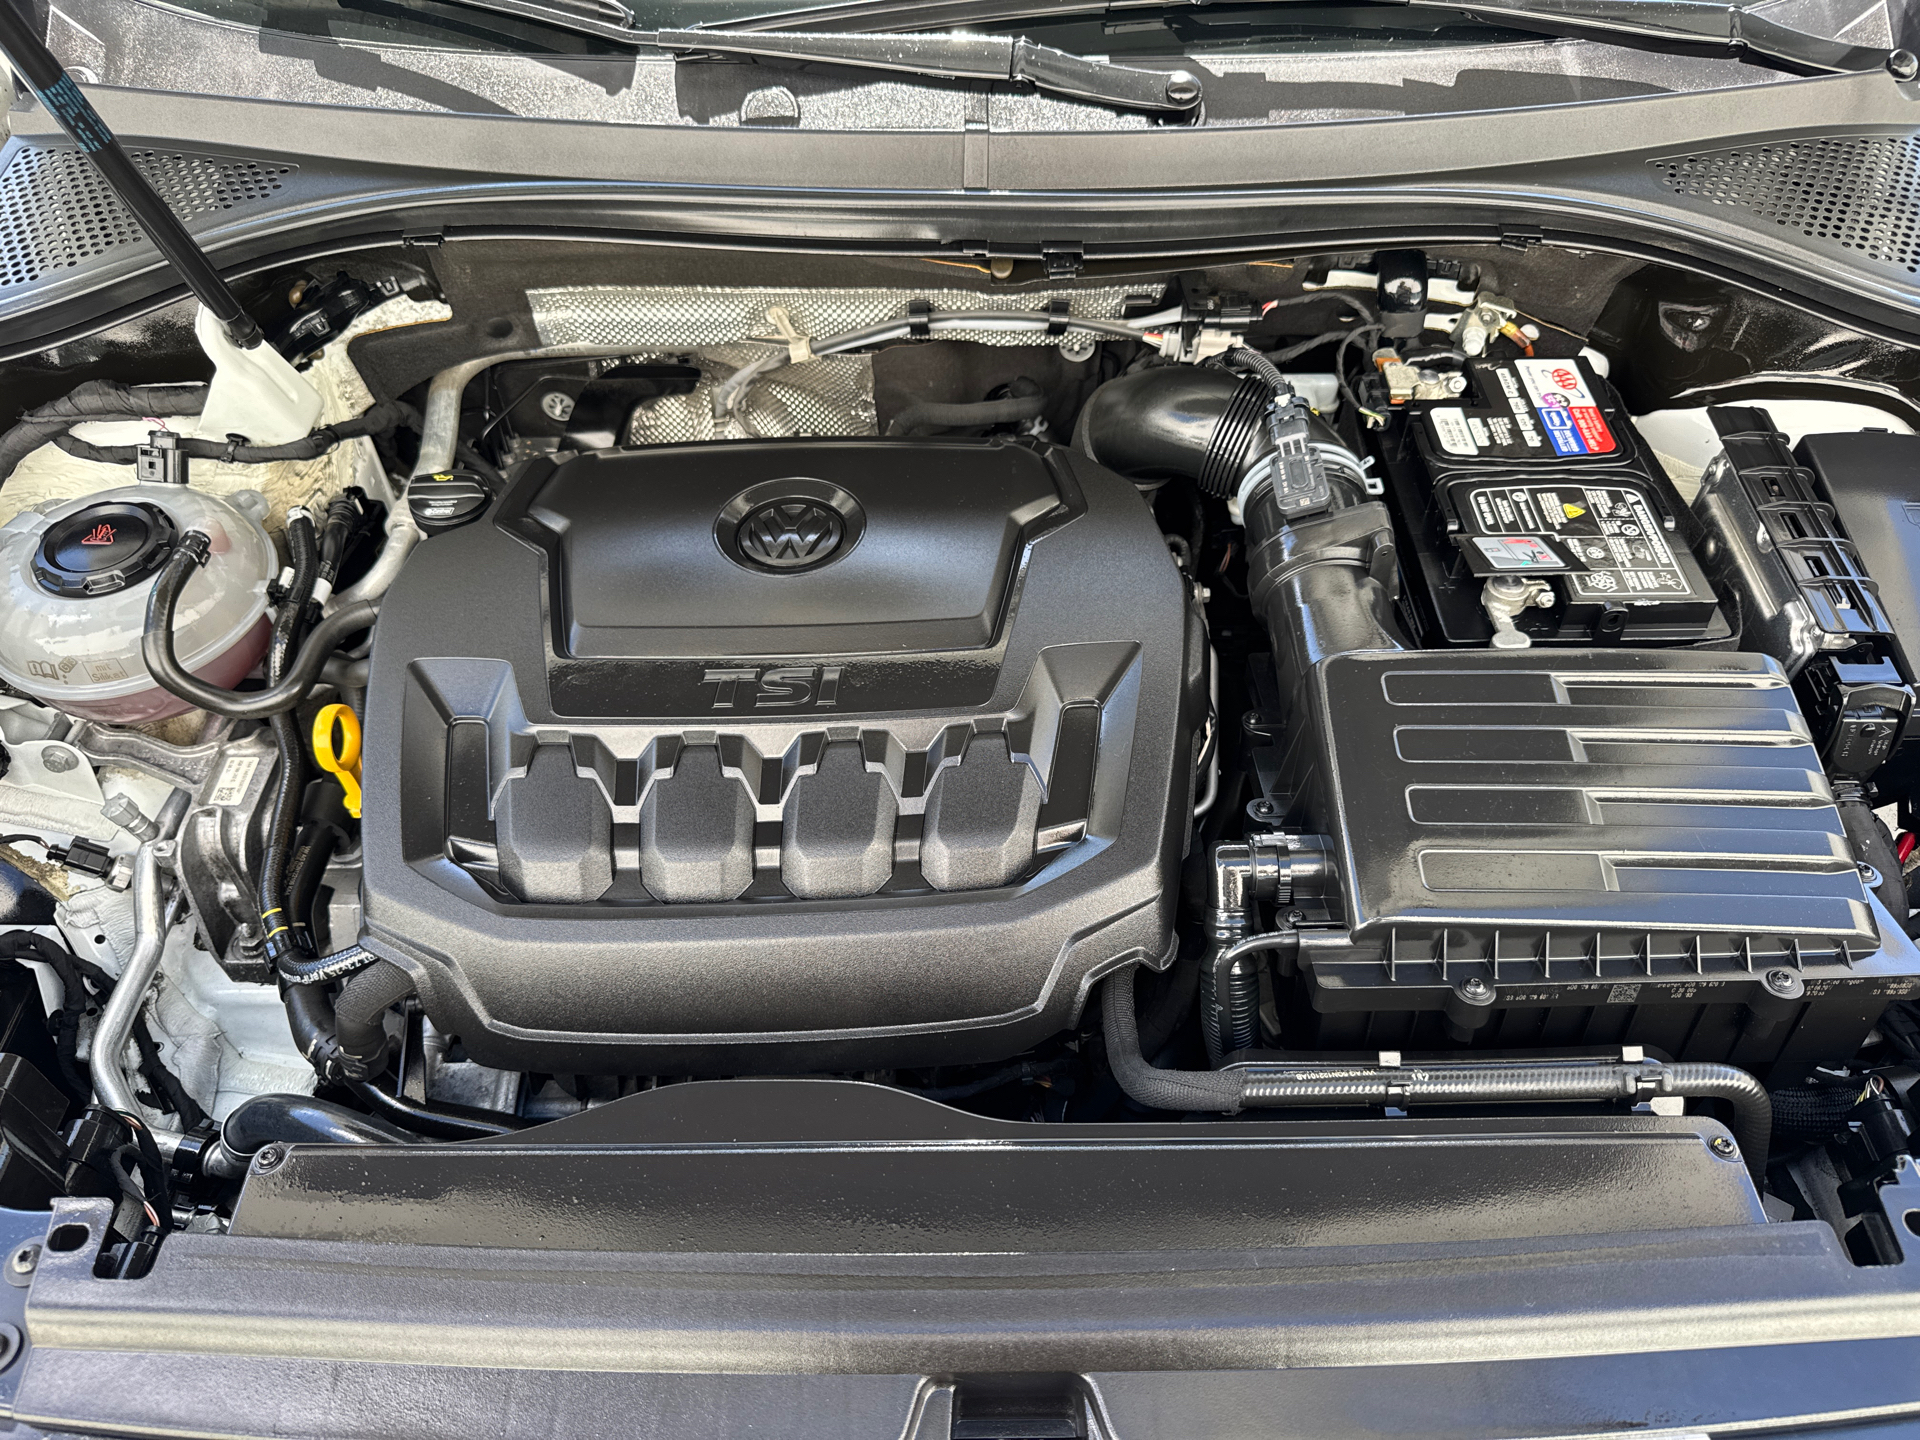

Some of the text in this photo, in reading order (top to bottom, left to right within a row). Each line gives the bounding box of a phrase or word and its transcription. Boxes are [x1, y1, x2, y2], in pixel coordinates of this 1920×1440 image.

[1552, 369, 1577, 390] AAA
[1553, 430, 1568, 452] INSTALLED
[1563, 430, 1580, 452] DELIVERED
[1632, 504, 1671, 564] DANGER/POISON
[93, 670, 126, 682] Silikat
[95, 662, 112, 672] mit
[702, 666, 846, 710] TSI
